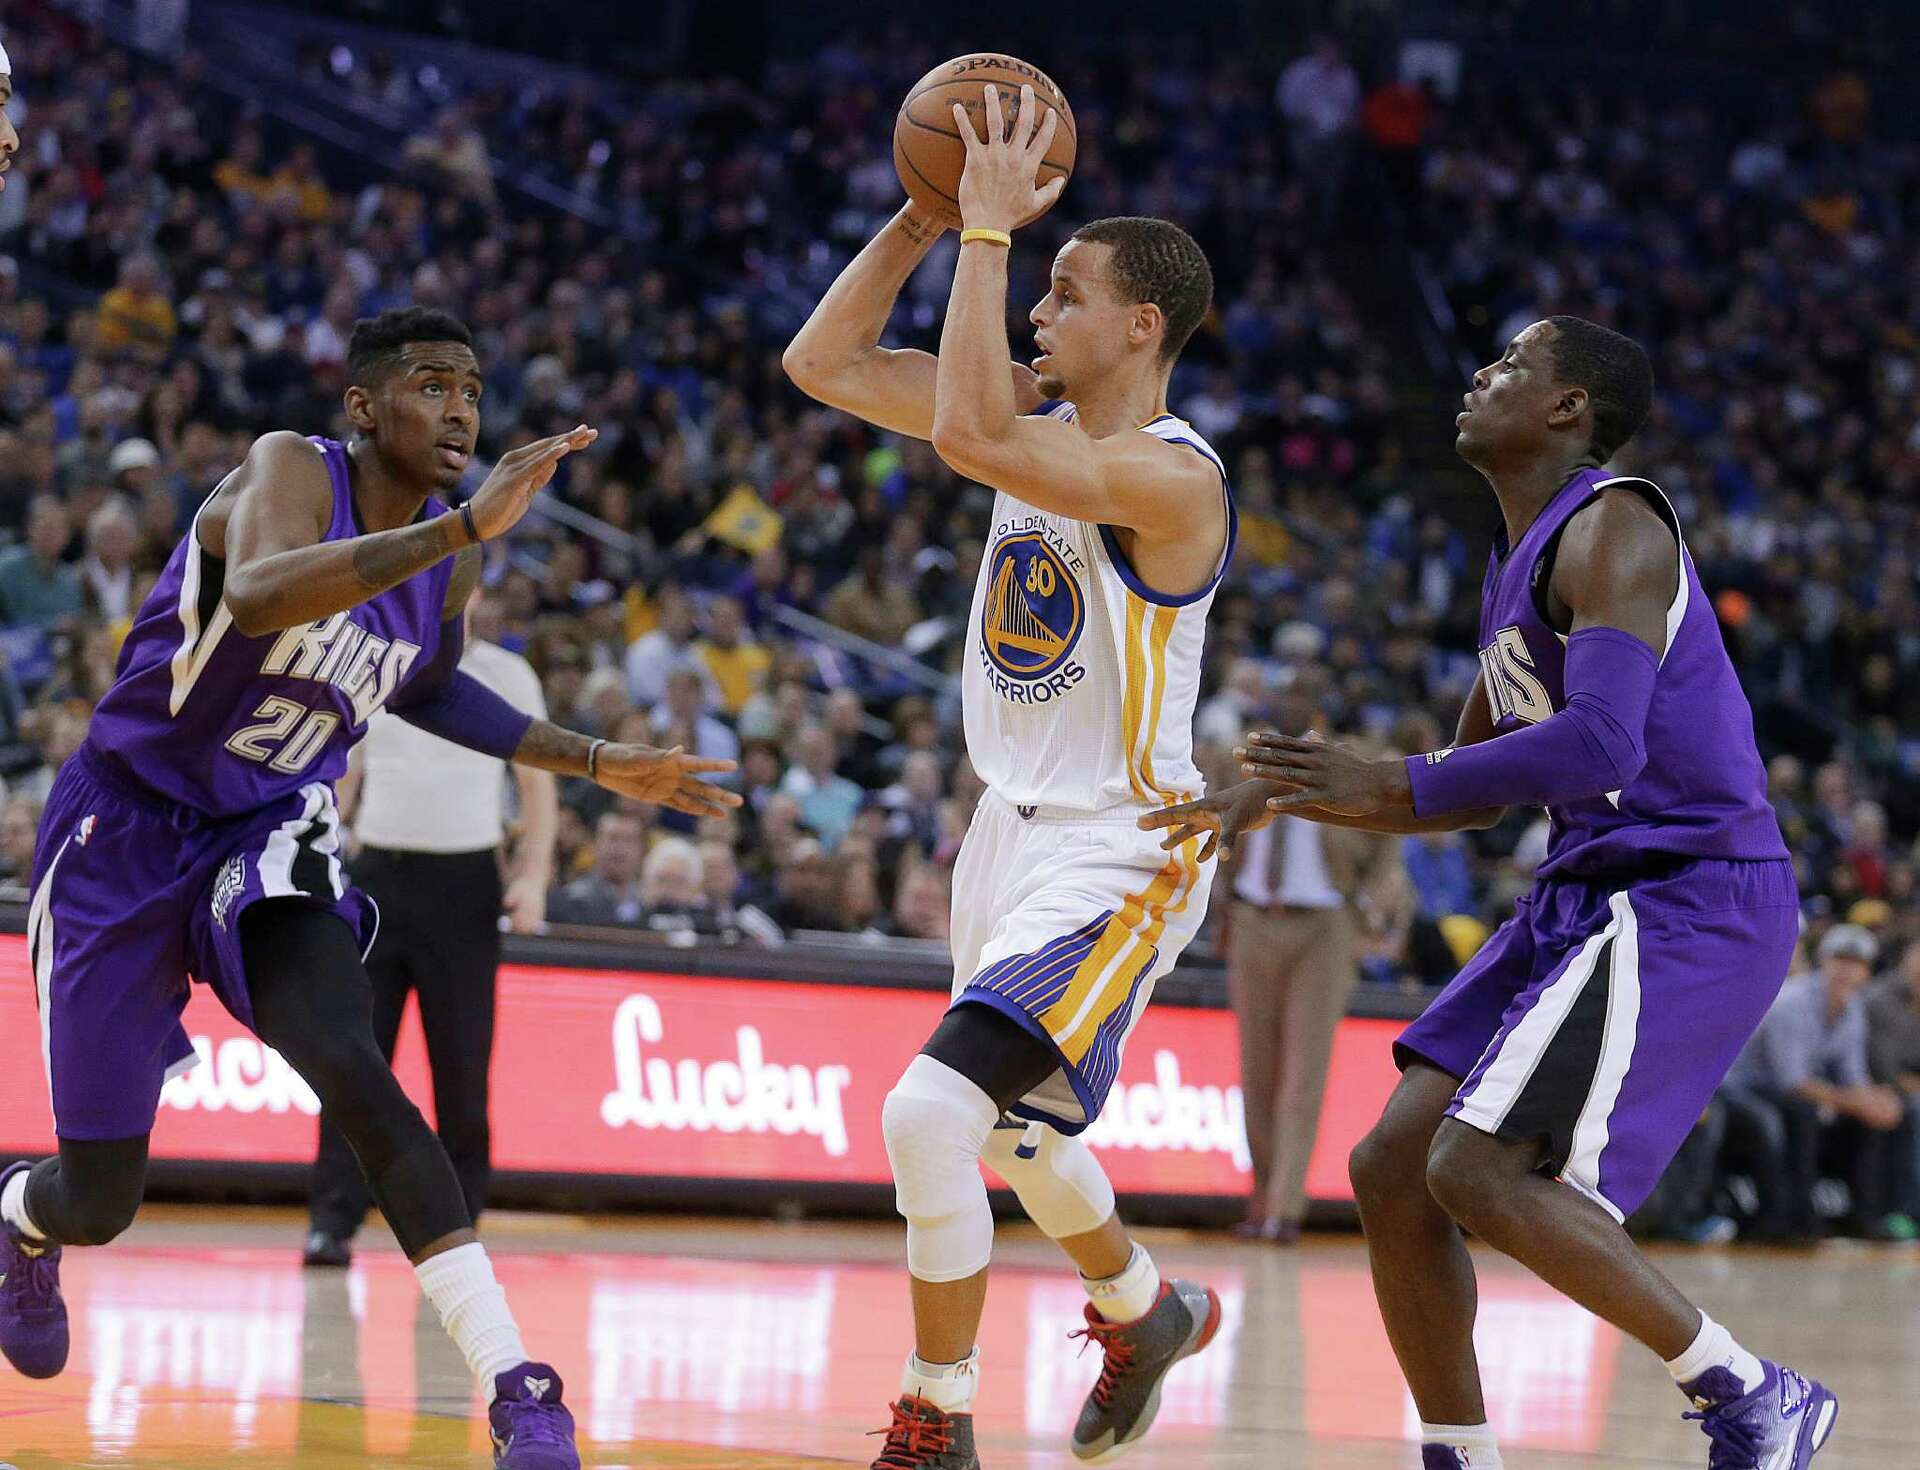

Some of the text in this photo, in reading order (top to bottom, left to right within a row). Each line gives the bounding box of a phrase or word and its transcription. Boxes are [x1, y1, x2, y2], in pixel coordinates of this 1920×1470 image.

[991, 515, 1085, 573] OLDEN TATE
[1025, 555, 1056, 598] 30
[224, 694, 342, 775] 20
[601, 993, 851, 1156] Lucky
[1080, 1050, 1253, 1173] ucky
